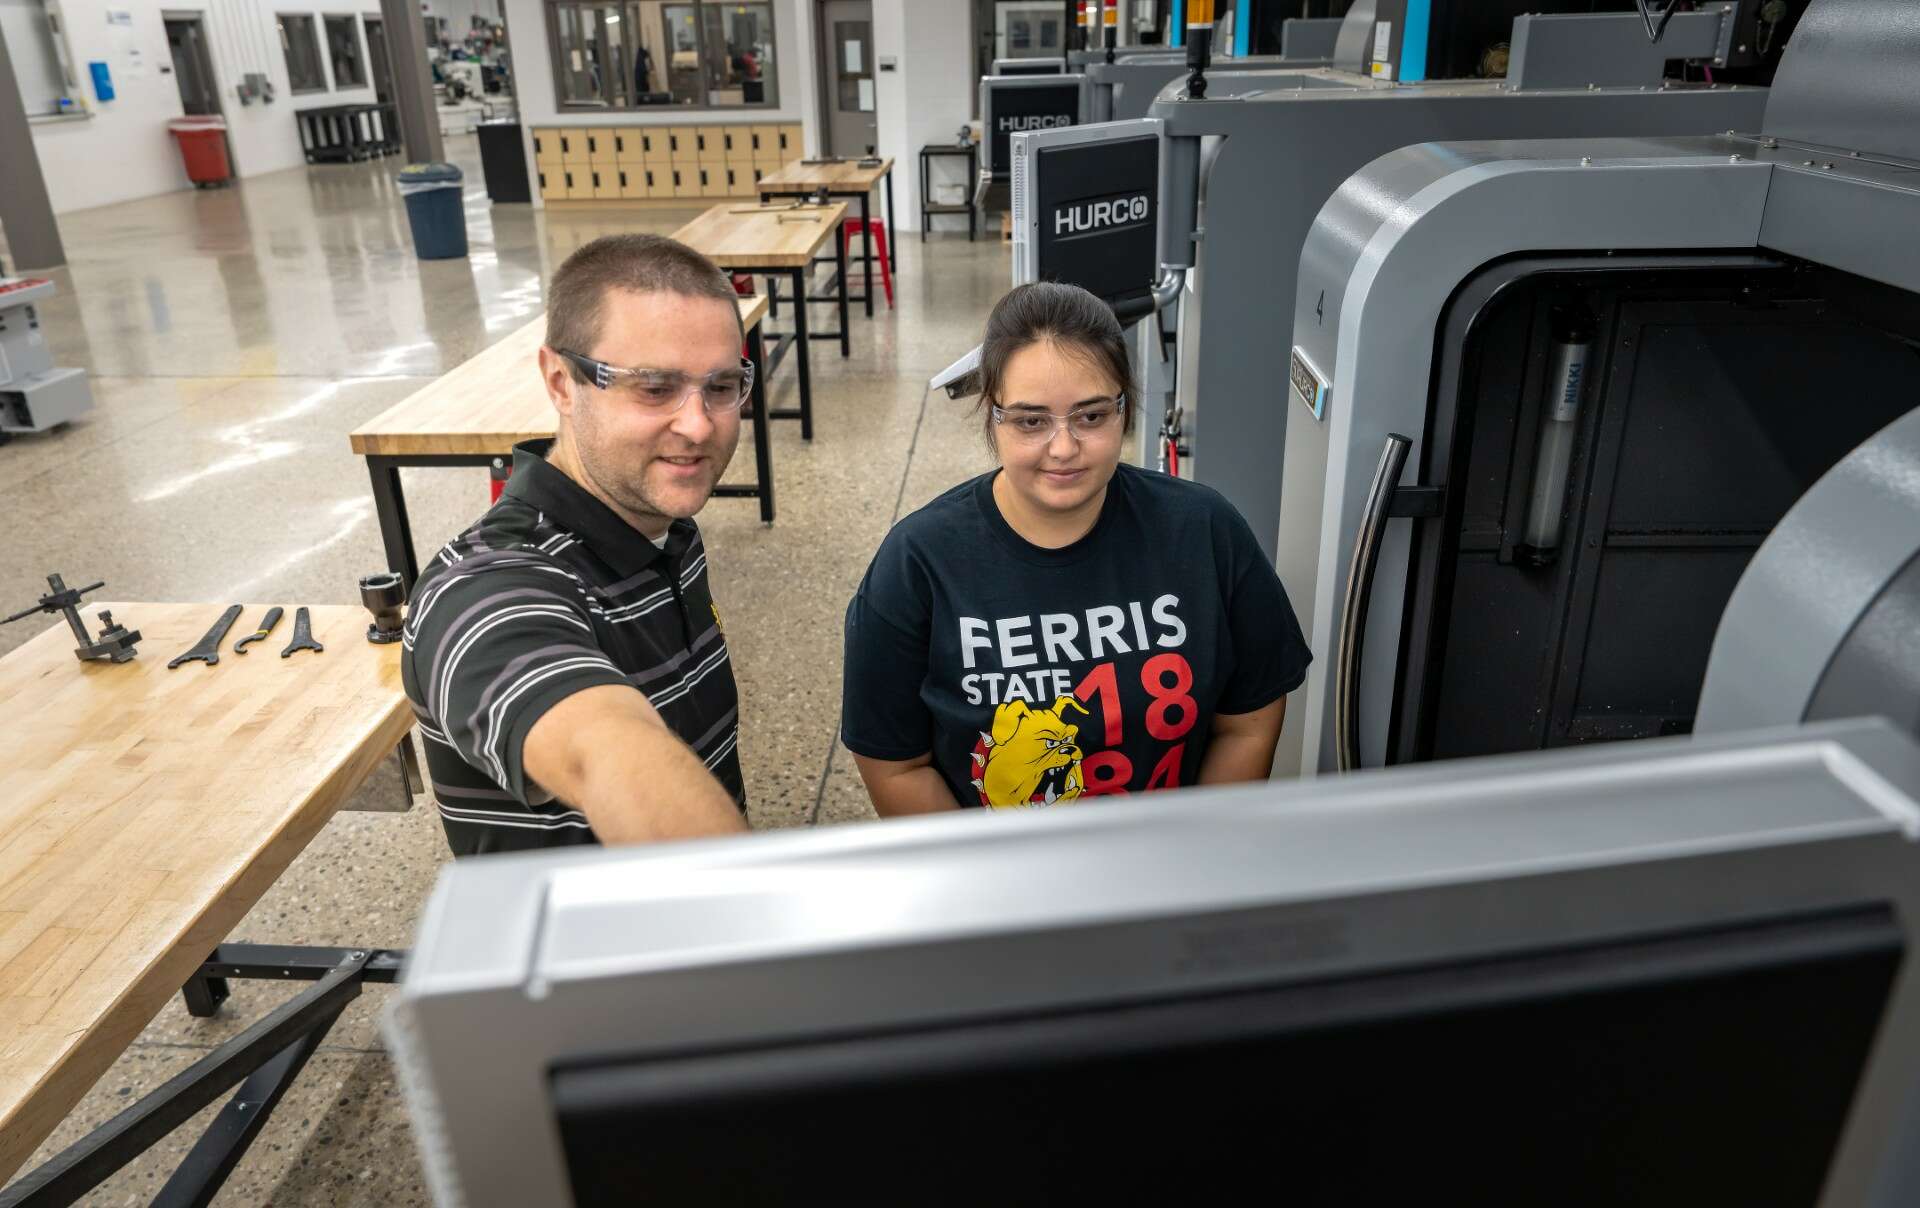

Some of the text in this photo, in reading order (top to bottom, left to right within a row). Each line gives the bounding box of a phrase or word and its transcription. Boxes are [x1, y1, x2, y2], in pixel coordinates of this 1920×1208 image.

[999, 114, 1070, 132] HURCO
[1054, 196, 1148, 235] HURCO
[1316, 289, 1325, 326] 4
[1564, 363, 1582, 404] NIKKI
[959, 593, 1187, 668] FERRIS
[961, 669, 1074, 705] STATE
[1073, 653, 1198, 747] 18
